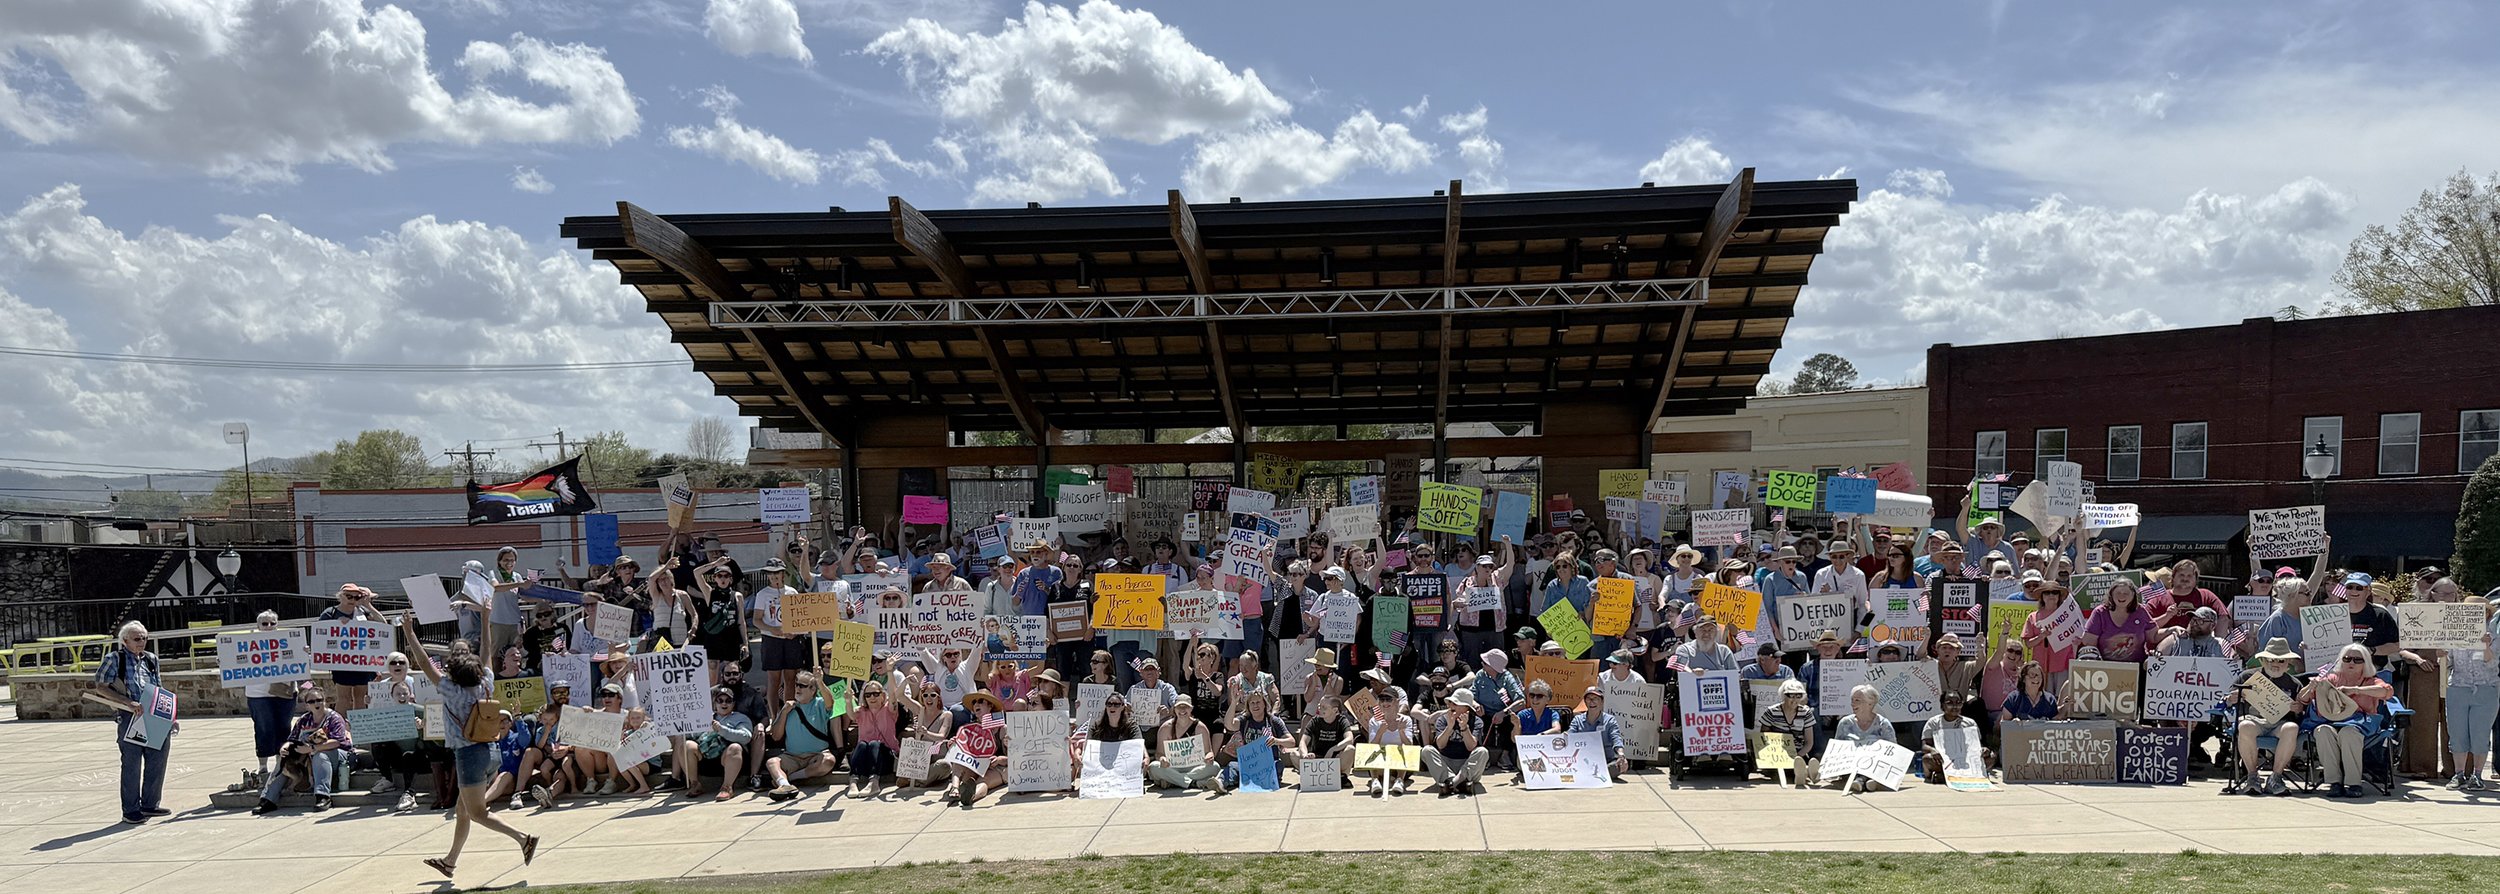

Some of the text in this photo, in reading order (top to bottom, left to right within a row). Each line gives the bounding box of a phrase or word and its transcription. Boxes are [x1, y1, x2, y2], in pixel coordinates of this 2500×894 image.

[1391, 459, 1414, 468] HANDS
[1279, 476, 1294, 486] YOU
[1391, 469, 1418, 482] OFF!
[1610, 473, 1638, 481] HANDS
[1774, 472, 1816, 489] STOP
[1193, 481, 1231, 492] HANDS
[1653, 481, 1675, 490] VETO
[1194, 492, 1212, 501] OFF
[1231, 488, 1254, 498] HANDS
[1647, 493, 1680, 502] CHEETO
[1770, 487, 1813, 503] DOGE
[2058, 487, 2077, 497] NOT
[1196, 501, 1209, 509] OF
[1431, 493, 1468, 511] HANDS
[1606, 498, 1625, 508] RUTH
[1058, 513, 1104, 523] DEMOCRACY
[1434, 510, 1460, 525] OFF!
[1607, 510, 1636, 520] SENT US
[2271, 507, 2318, 519] The People
[1019, 522, 1051, 530] TRUMP
[1343, 516, 1360, 524] OUR
[2253, 523, 2272, 531] have
[1231, 529, 1252, 543] ARE
[2258, 547, 2308, 558] HANDS OFF
[1100, 579, 1112, 590] This
[1407, 585, 1441, 596] OFF!
[790, 595, 834, 605] IMPEACH
[1714, 587, 1747, 602] HANDS
[1106, 594, 1131, 608] There
[1177, 598, 1204, 607] HANDS
[1704, 599, 1745, 613] OFF MY
[790, 607, 808, 617] THE
[918, 609, 977, 622] not hate
[1104, 609, 1116, 624] No
[1180, 608, 1196, 617] OFF
[1711, 609, 1746, 624] AMIGOS
[1793, 602, 1845, 620] DEFEND
[1992, 607, 2021, 618] TOOTH
[2301, 605, 2349, 625] HANDS
[791, 617, 832, 628] DICTATOR
[1000, 616, 1022, 624] TRUST
[2044, 610, 2069, 632] HANDS
[330, 626, 375, 637] HANDS
[838, 624, 866, 642] Hands
[909, 623, 942, 632] makes
[2313, 620, 2345, 639] OFF
[237, 638, 288, 652] HANDS
[340, 640, 366, 650] OFF
[909, 634, 950, 645] AMERICA
[251, 651, 278, 664] OFF
[651, 652, 703, 670] HANDS
[550, 658, 576, 671] Hands
[2147, 656, 2167, 677] PBS
[223, 663, 307, 681] DEMOCRACY
[663, 669, 695, 684] OFF
[1535, 663, 1576, 681] Courage
[500, 680, 532, 691] HANDS
[2073, 671, 2108, 690] NO
[2174, 672, 2219, 687] REAL
[674, 684, 697, 692] BODIES
[1611, 686, 1648, 698] Kamala
[2257, 676, 2278, 697] HANDS
[506, 690, 522, 699] OFF
[679, 693, 703, 702] RIGHTS
[1080, 688, 1108, 698] HANDS
[2146, 688, 2224, 700] JOURNALIS
[664, 702, 705, 714] FREE PRESS
[1632, 700, 1653, 710] said
[1908, 701, 1932, 713] CDC
[2073, 691, 2134, 714] KING
[662, 712, 687, 721] SCIENCE
[2146, 702, 2204, 719] SCARES
[1630, 712, 1655, 722] would
[1685, 713, 1735, 727] HONOR
[1013, 713, 1066, 736] HANDS
[1696, 726, 1731, 736] VETS
[2043, 730, 2091, 740] CHAOS
[960, 728, 994, 751] STOP
[1690, 737, 1713, 745] DON'T
[2124, 729, 2183, 746] Protect
[1023, 740, 1052, 751] OFF
[1168, 738, 1195, 750] HANDS
[2029, 740, 2111, 752] TRADE WARS
[1180, 749, 1192, 757] OFF
[2027, 751, 2108, 764] AUTOCRACY
[2129, 746, 2165, 757] OUR
[955, 752, 980, 769] ELON
[2124, 757, 2178, 770] PUBLIC
[1303, 761, 1335, 773] FUCK
[1856, 756, 1902, 780] OFF
[2006, 764, 2114, 780] ARE WE GREAT YET?
[1310, 774, 1333, 786] ICE
[2122, 768, 2177, 783] LANDS
